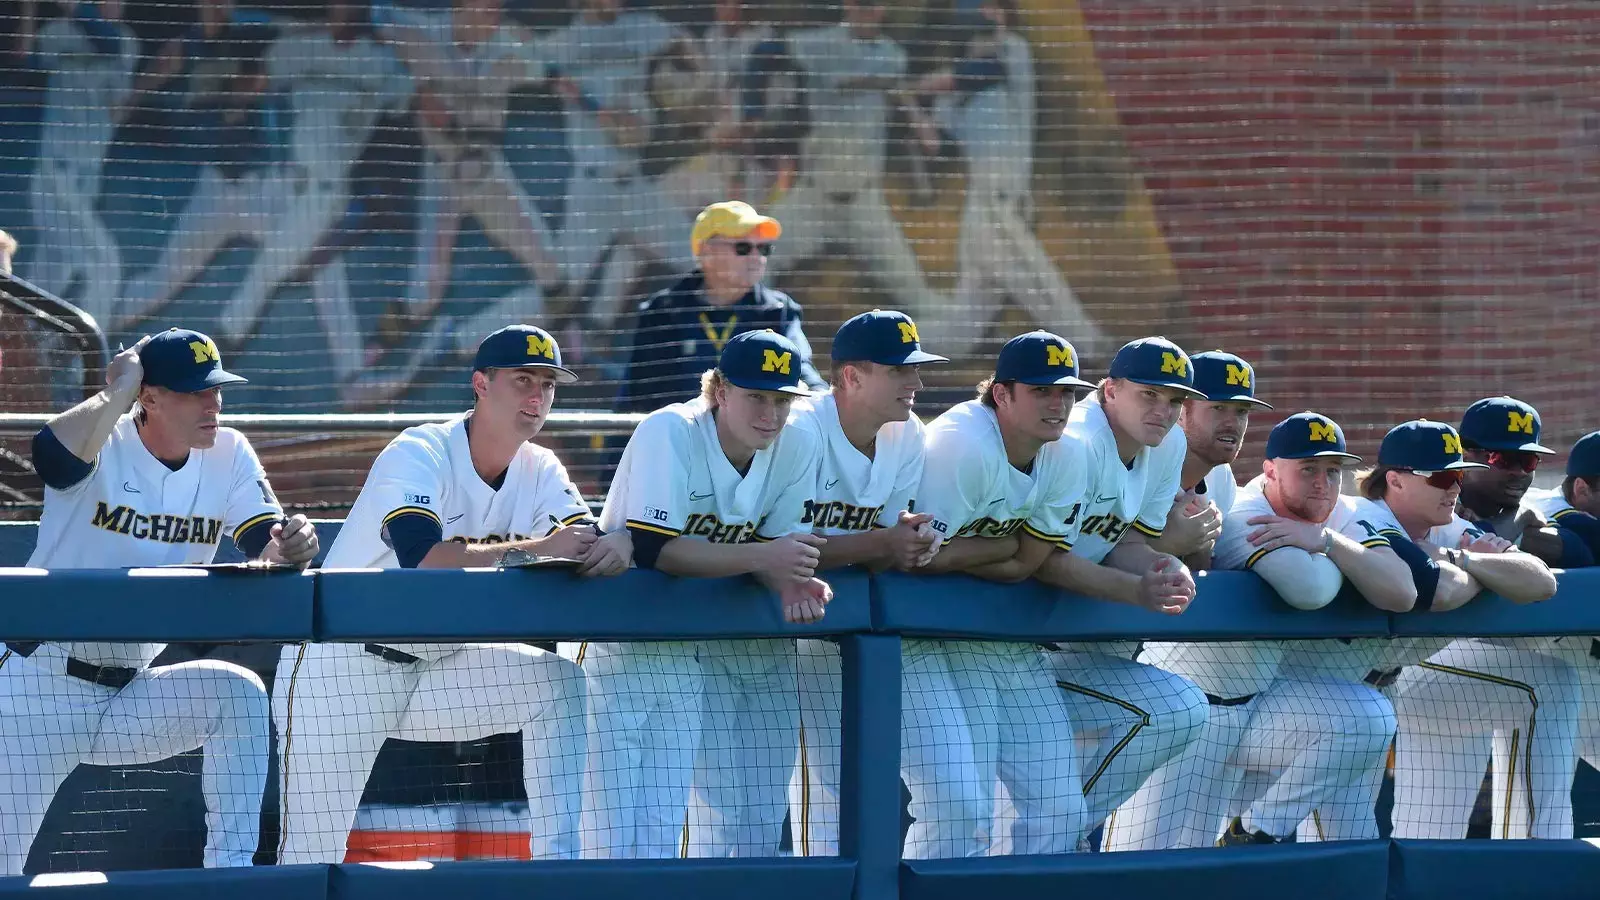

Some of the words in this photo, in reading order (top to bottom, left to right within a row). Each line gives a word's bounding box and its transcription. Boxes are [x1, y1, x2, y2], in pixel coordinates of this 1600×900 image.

[897, 322, 919, 343] M
[189, 341, 219, 363] M
[526, 336, 553, 358] M
[1047, 345, 1074, 367] M
[762, 350, 791, 375] M
[1162, 352, 1188, 376] M
[1226, 364, 1251, 388] M
[1309, 420, 1336, 442] M
[1507, 411, 1533, 434] M
[1442, 433, 1463, 453] M
[91, 501, 224, 545] MICHIGAN
